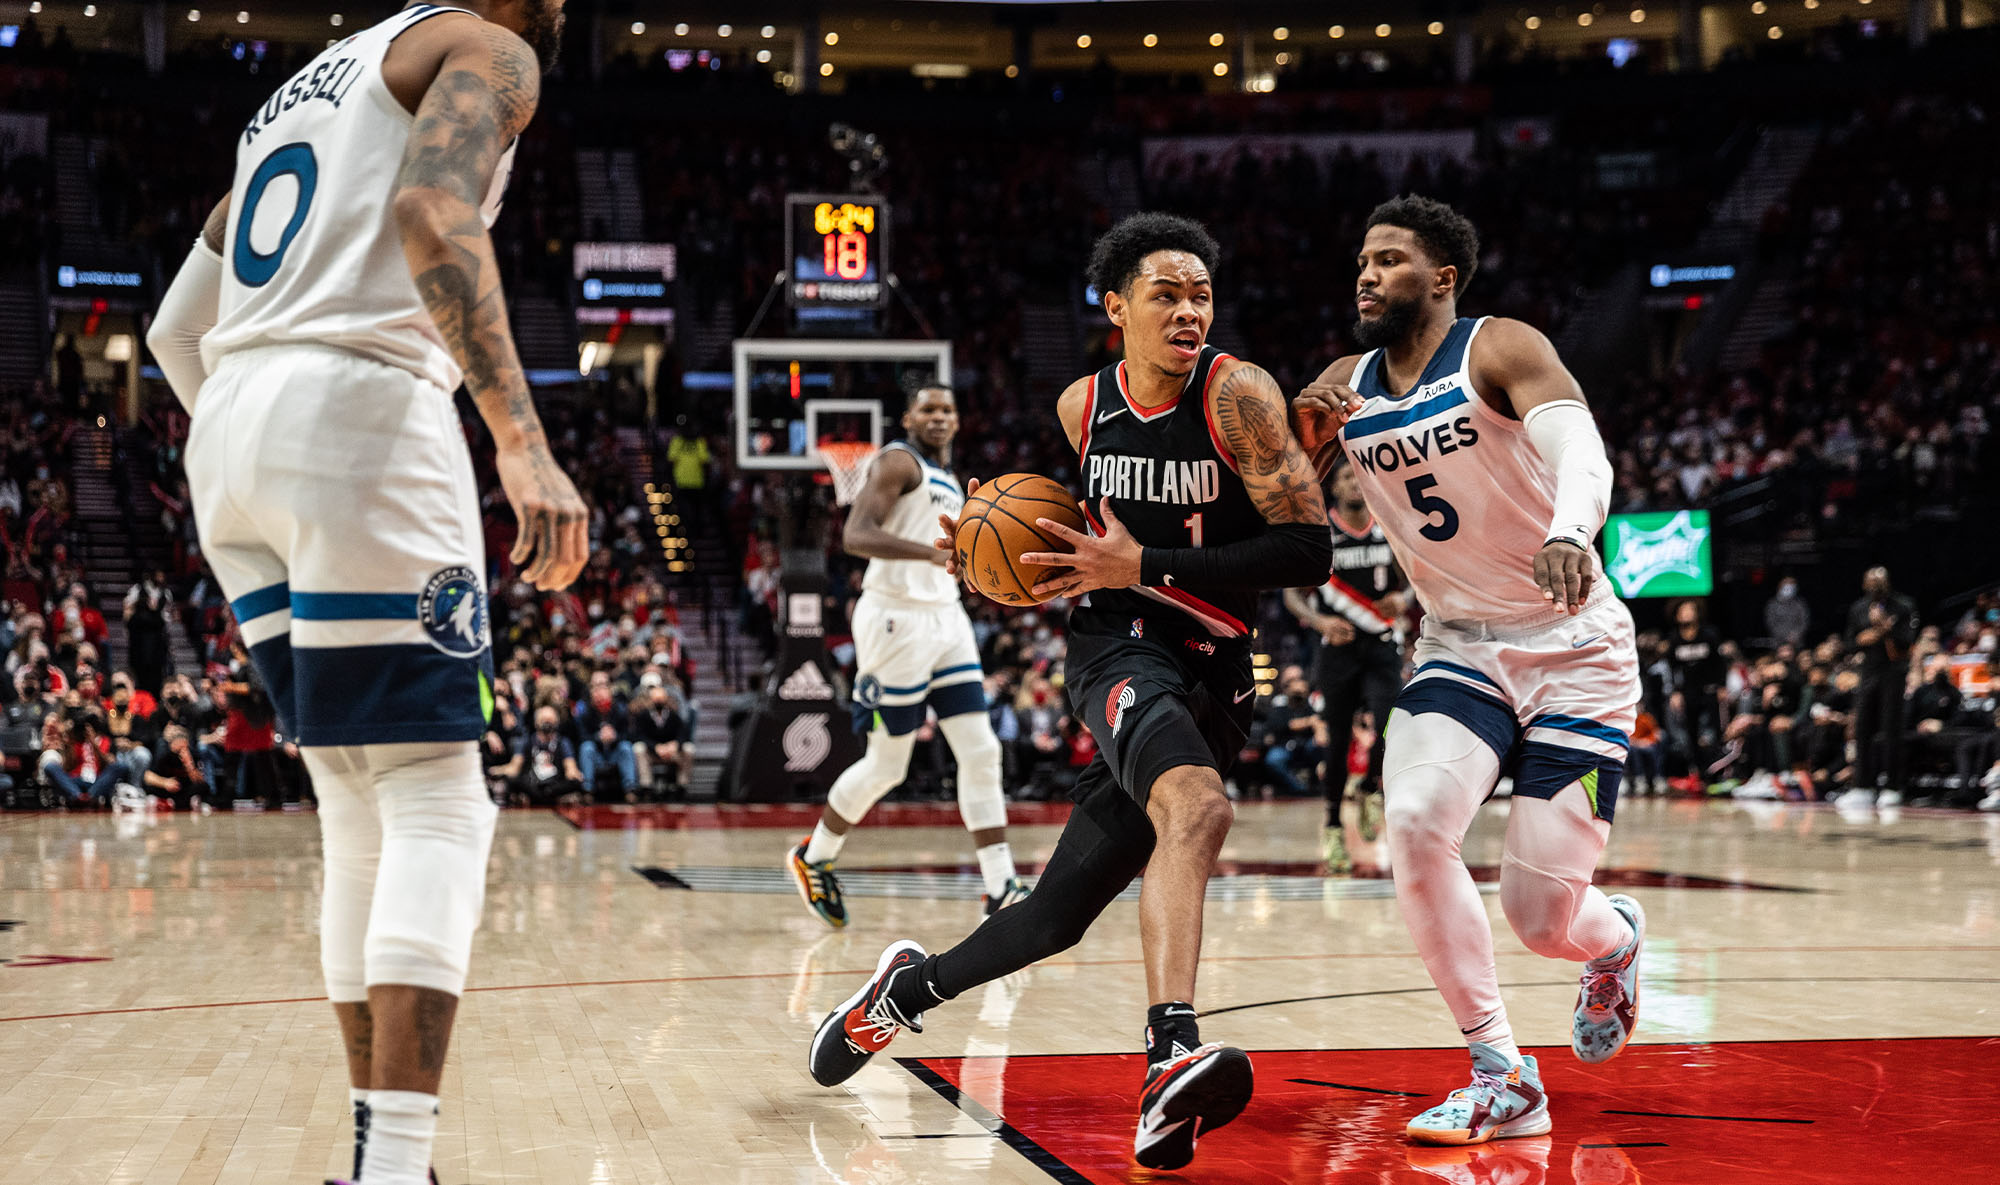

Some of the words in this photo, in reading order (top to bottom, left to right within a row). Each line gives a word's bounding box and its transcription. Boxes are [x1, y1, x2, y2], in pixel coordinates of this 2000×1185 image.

[246, 57, 364, 145] RUSSELL
[233, 142, 319, 288] 0
[815, 203, 874, 234] 6:24
[824, 232, 867, 280] 18
[1352, 417, 1479, 475] WOLVES
[1089, 454, 1219, 505] PORTLAND
[1184, 512, 1203, 549] 1
[1405, 473, 1459, 542] 5
